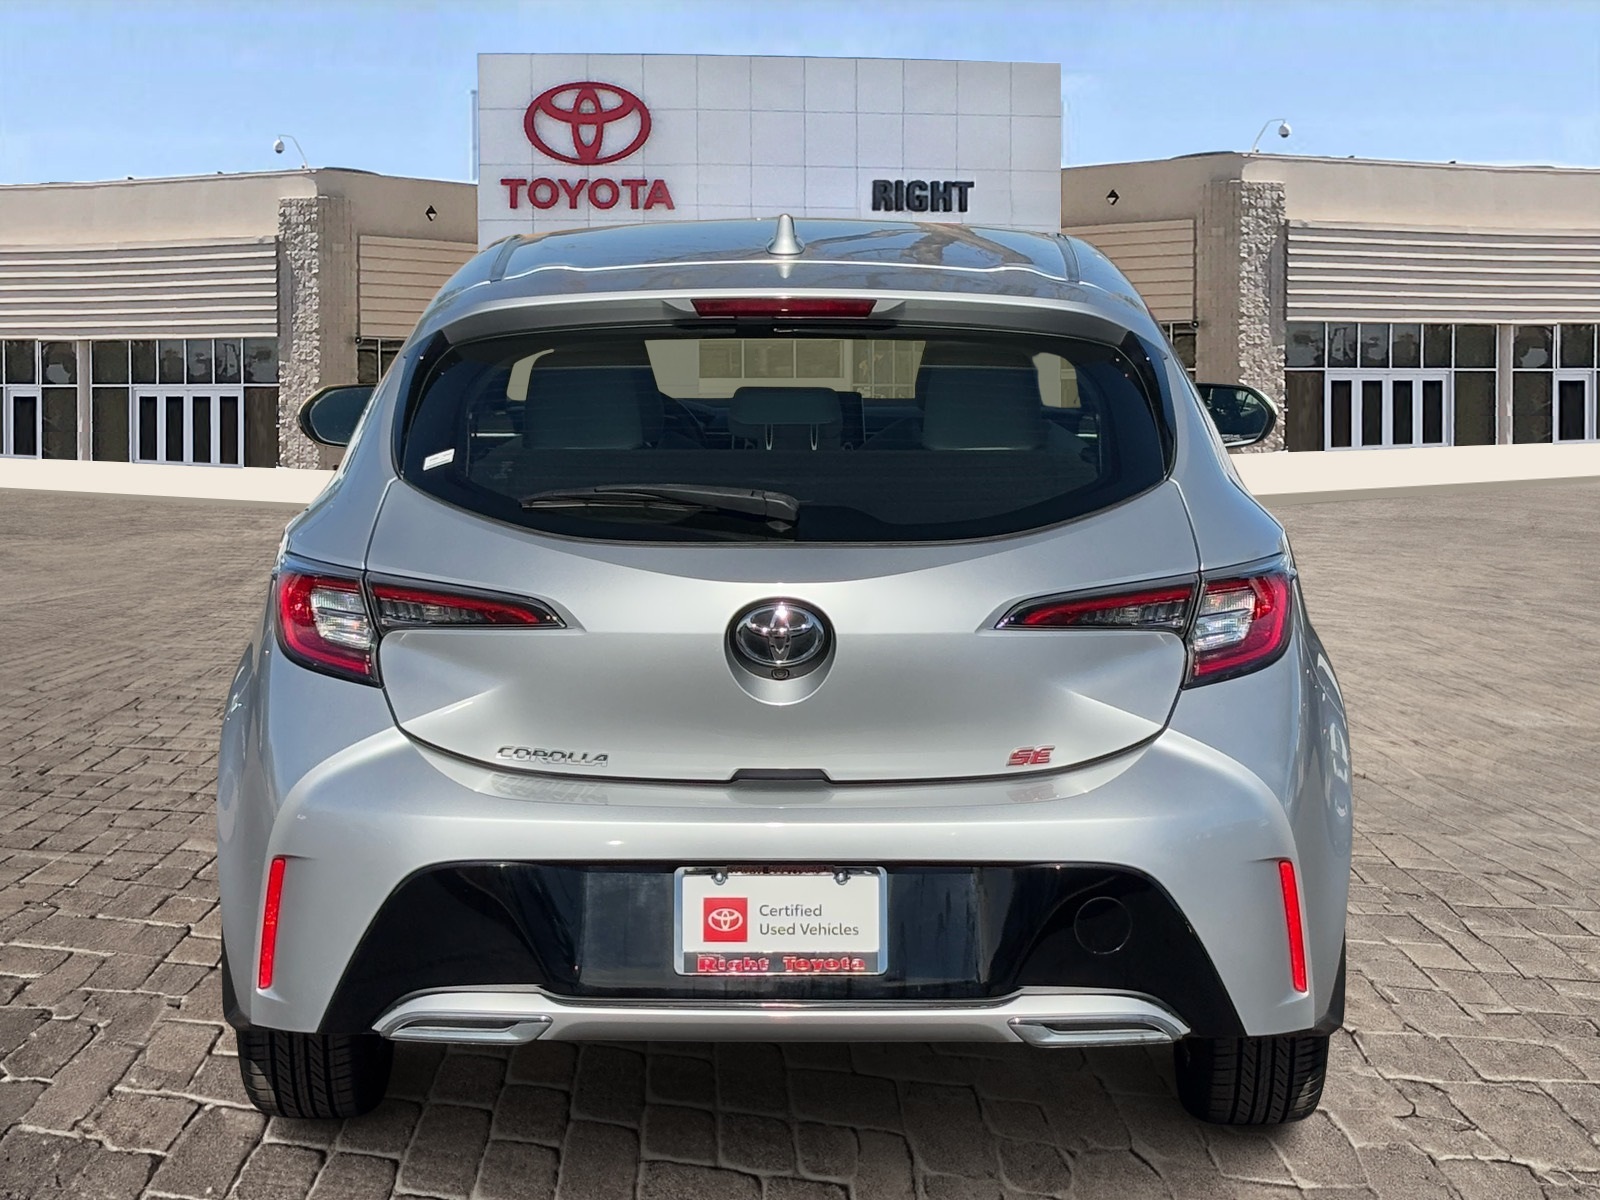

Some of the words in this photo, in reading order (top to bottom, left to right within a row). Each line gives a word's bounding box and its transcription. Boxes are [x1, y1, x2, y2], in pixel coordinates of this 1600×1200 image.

[500, 178, 675, 210] TOYOTA
[871, 180, 975, 213] RIGHT
[496, 746, 608, 767] COROLLA
[1007, 746, 1056, 766] SE
[759, 904, 822, 917] Certified
[759, 923, 796, 936] Used
[800, 922, 859, 936] Vehicles
[697, 954, 769, 972] Right
[783, 956, 865, 972] Toyota
